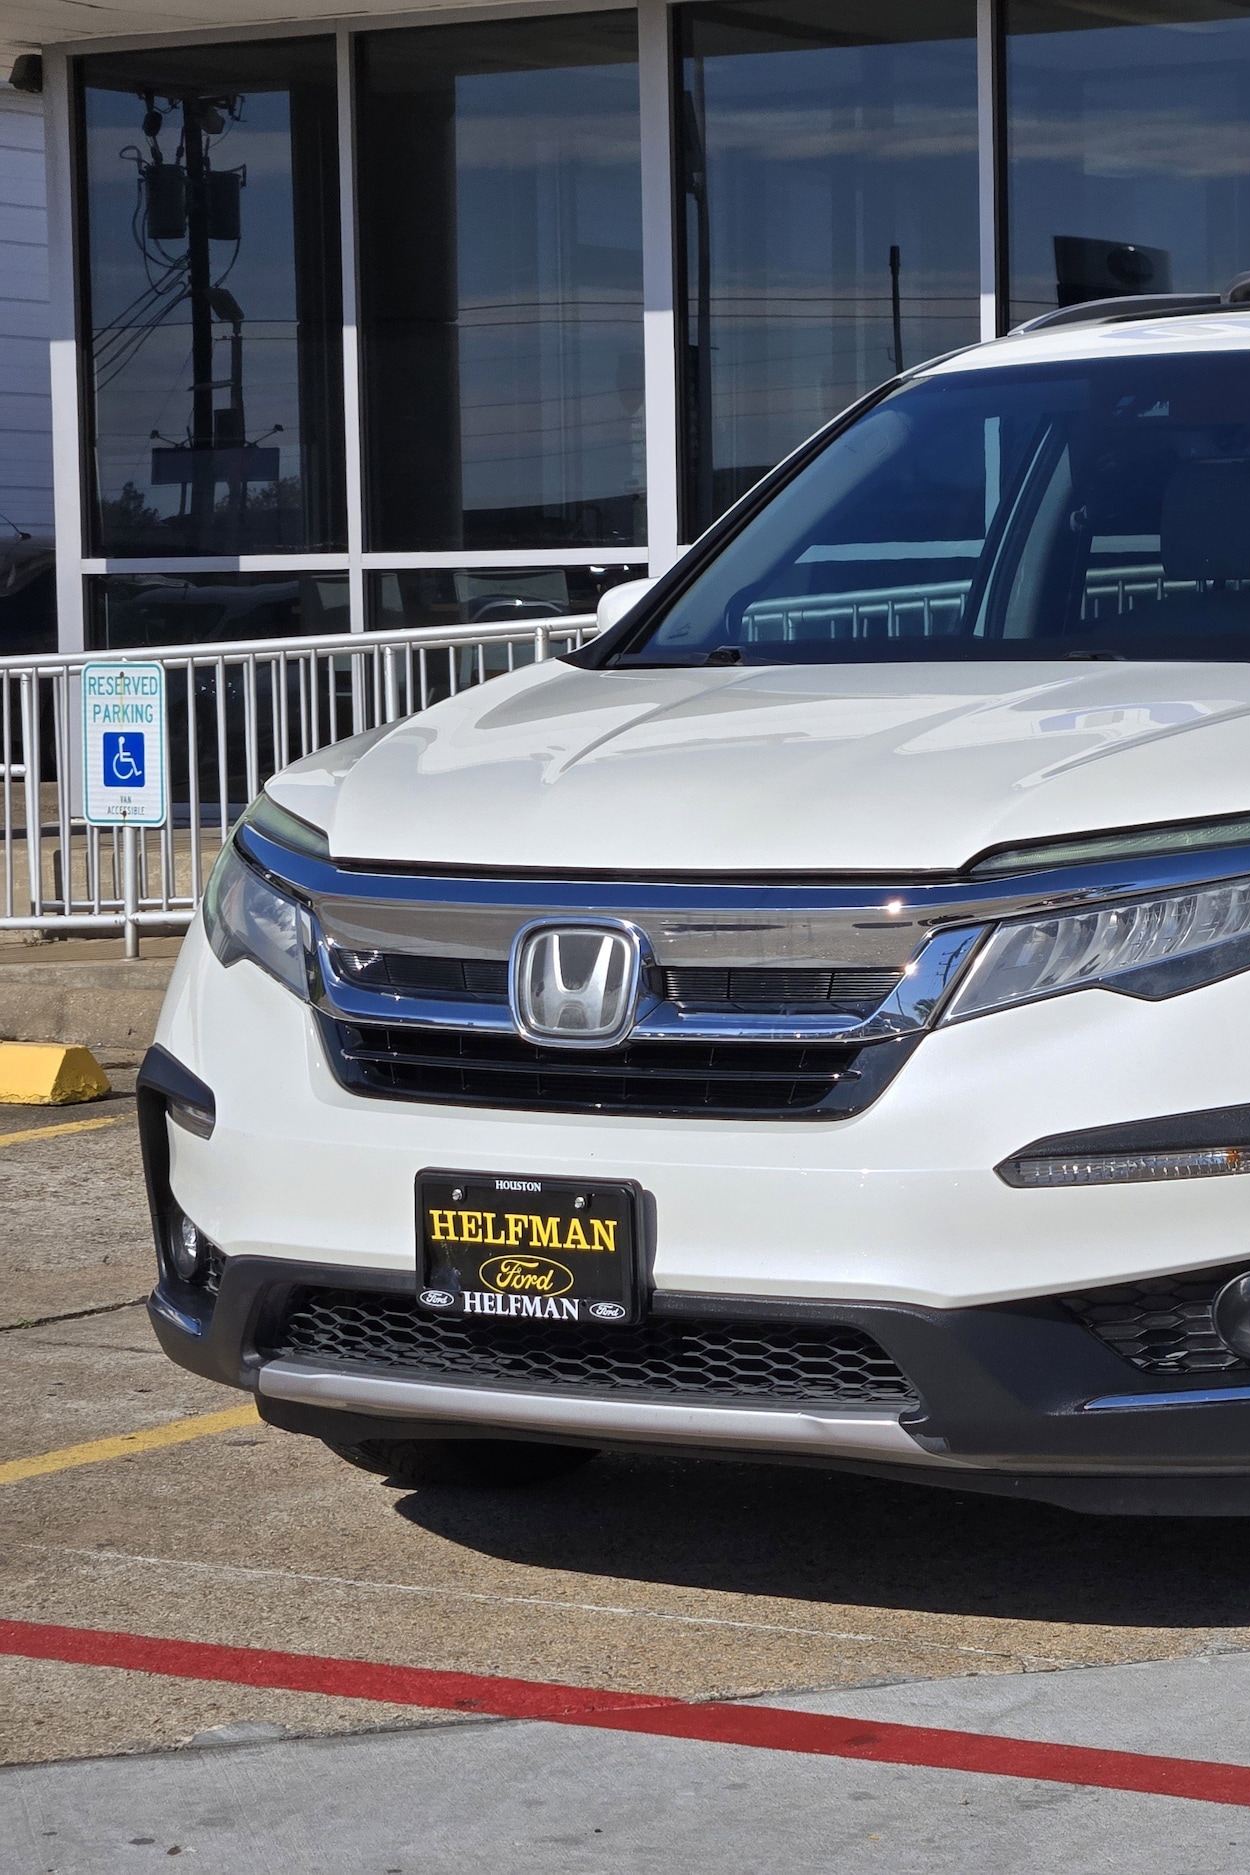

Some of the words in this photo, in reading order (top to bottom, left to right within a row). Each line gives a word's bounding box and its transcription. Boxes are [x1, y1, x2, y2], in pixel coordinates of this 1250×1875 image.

[88, 676, 158, 696] RESERVED
[93, 704, 154, 724] PARKING
[120, 795, 132, 804] VAN
[495, 1180, 542, 1192] HOUSTON
[429, 1209, 618, 1252] HELFMAN
[496, 1259, 554, 1291] Ford
[461, 1291, 580, 1321] HELFMAN
